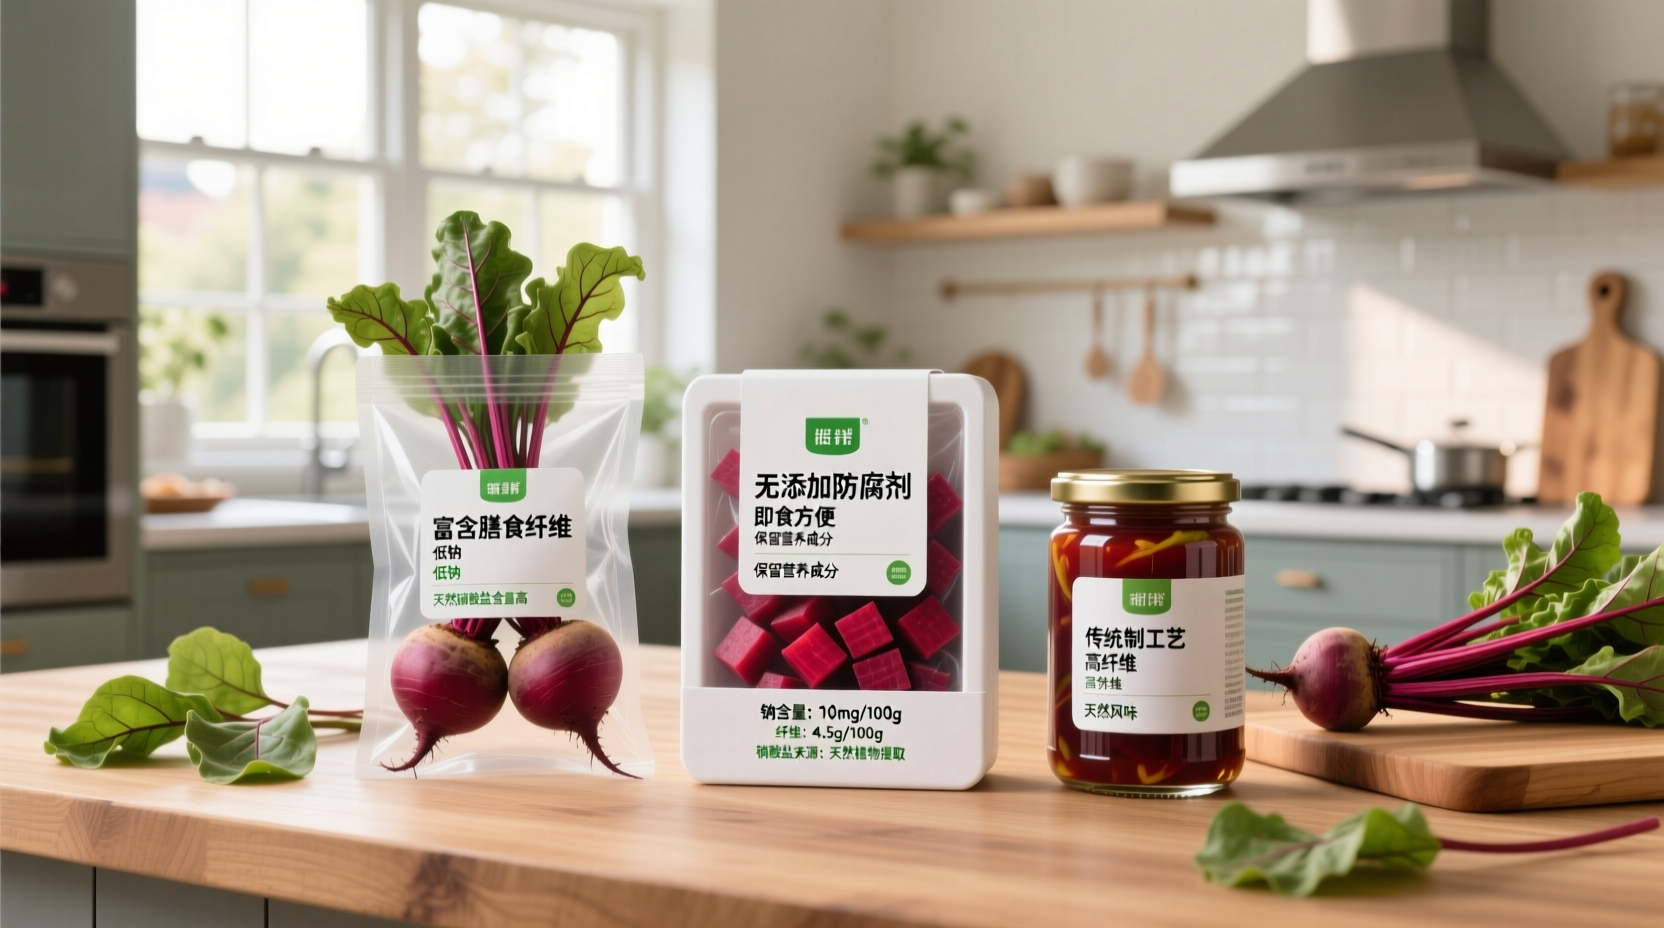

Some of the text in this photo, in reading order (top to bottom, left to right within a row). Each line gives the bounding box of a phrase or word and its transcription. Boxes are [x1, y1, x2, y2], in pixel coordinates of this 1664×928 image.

[754, 471, 912, 500] 无添加防腐剂
[433, 514, 573, 541] 富含膳食纤维
[754, 505, 836, 528] 即食方便
[1085, 626, 1186, 650] 传统制工艺
[1085, 652, 1138, 673] 高纤维
[1084, 702, 1138, 721] 天然风味
